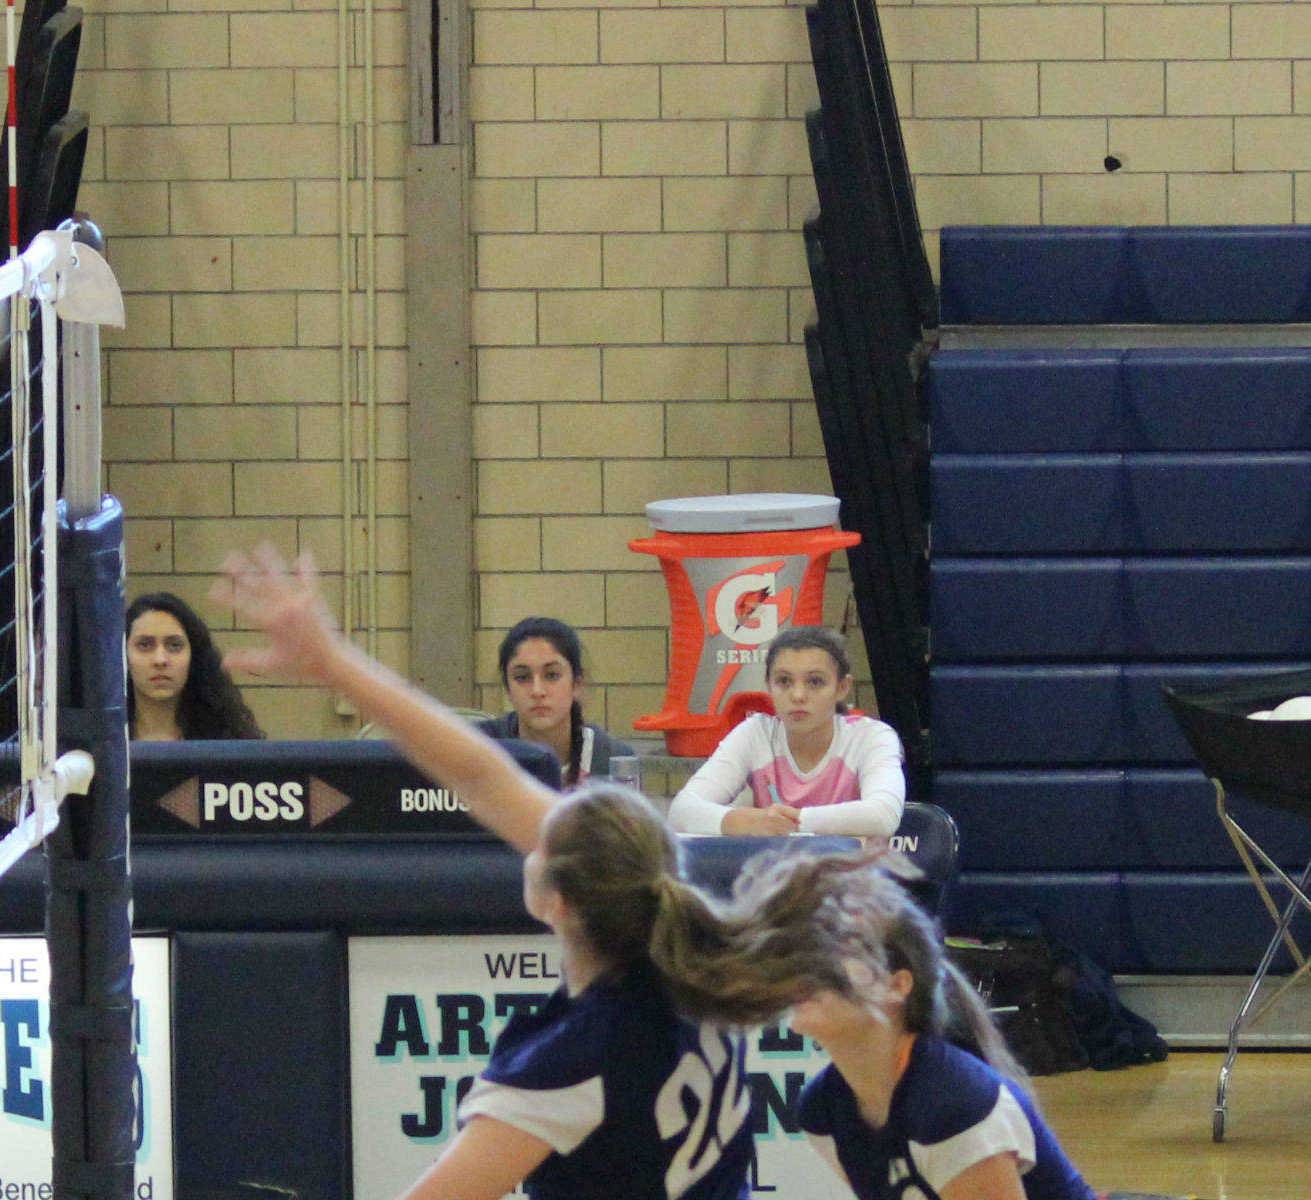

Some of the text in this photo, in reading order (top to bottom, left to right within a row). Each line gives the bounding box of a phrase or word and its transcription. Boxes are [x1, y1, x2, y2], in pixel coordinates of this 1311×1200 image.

[715, 572, 779, 645] G
[716, 650, 769, 665] SERI
[204, 781, 304, 821] POSS
